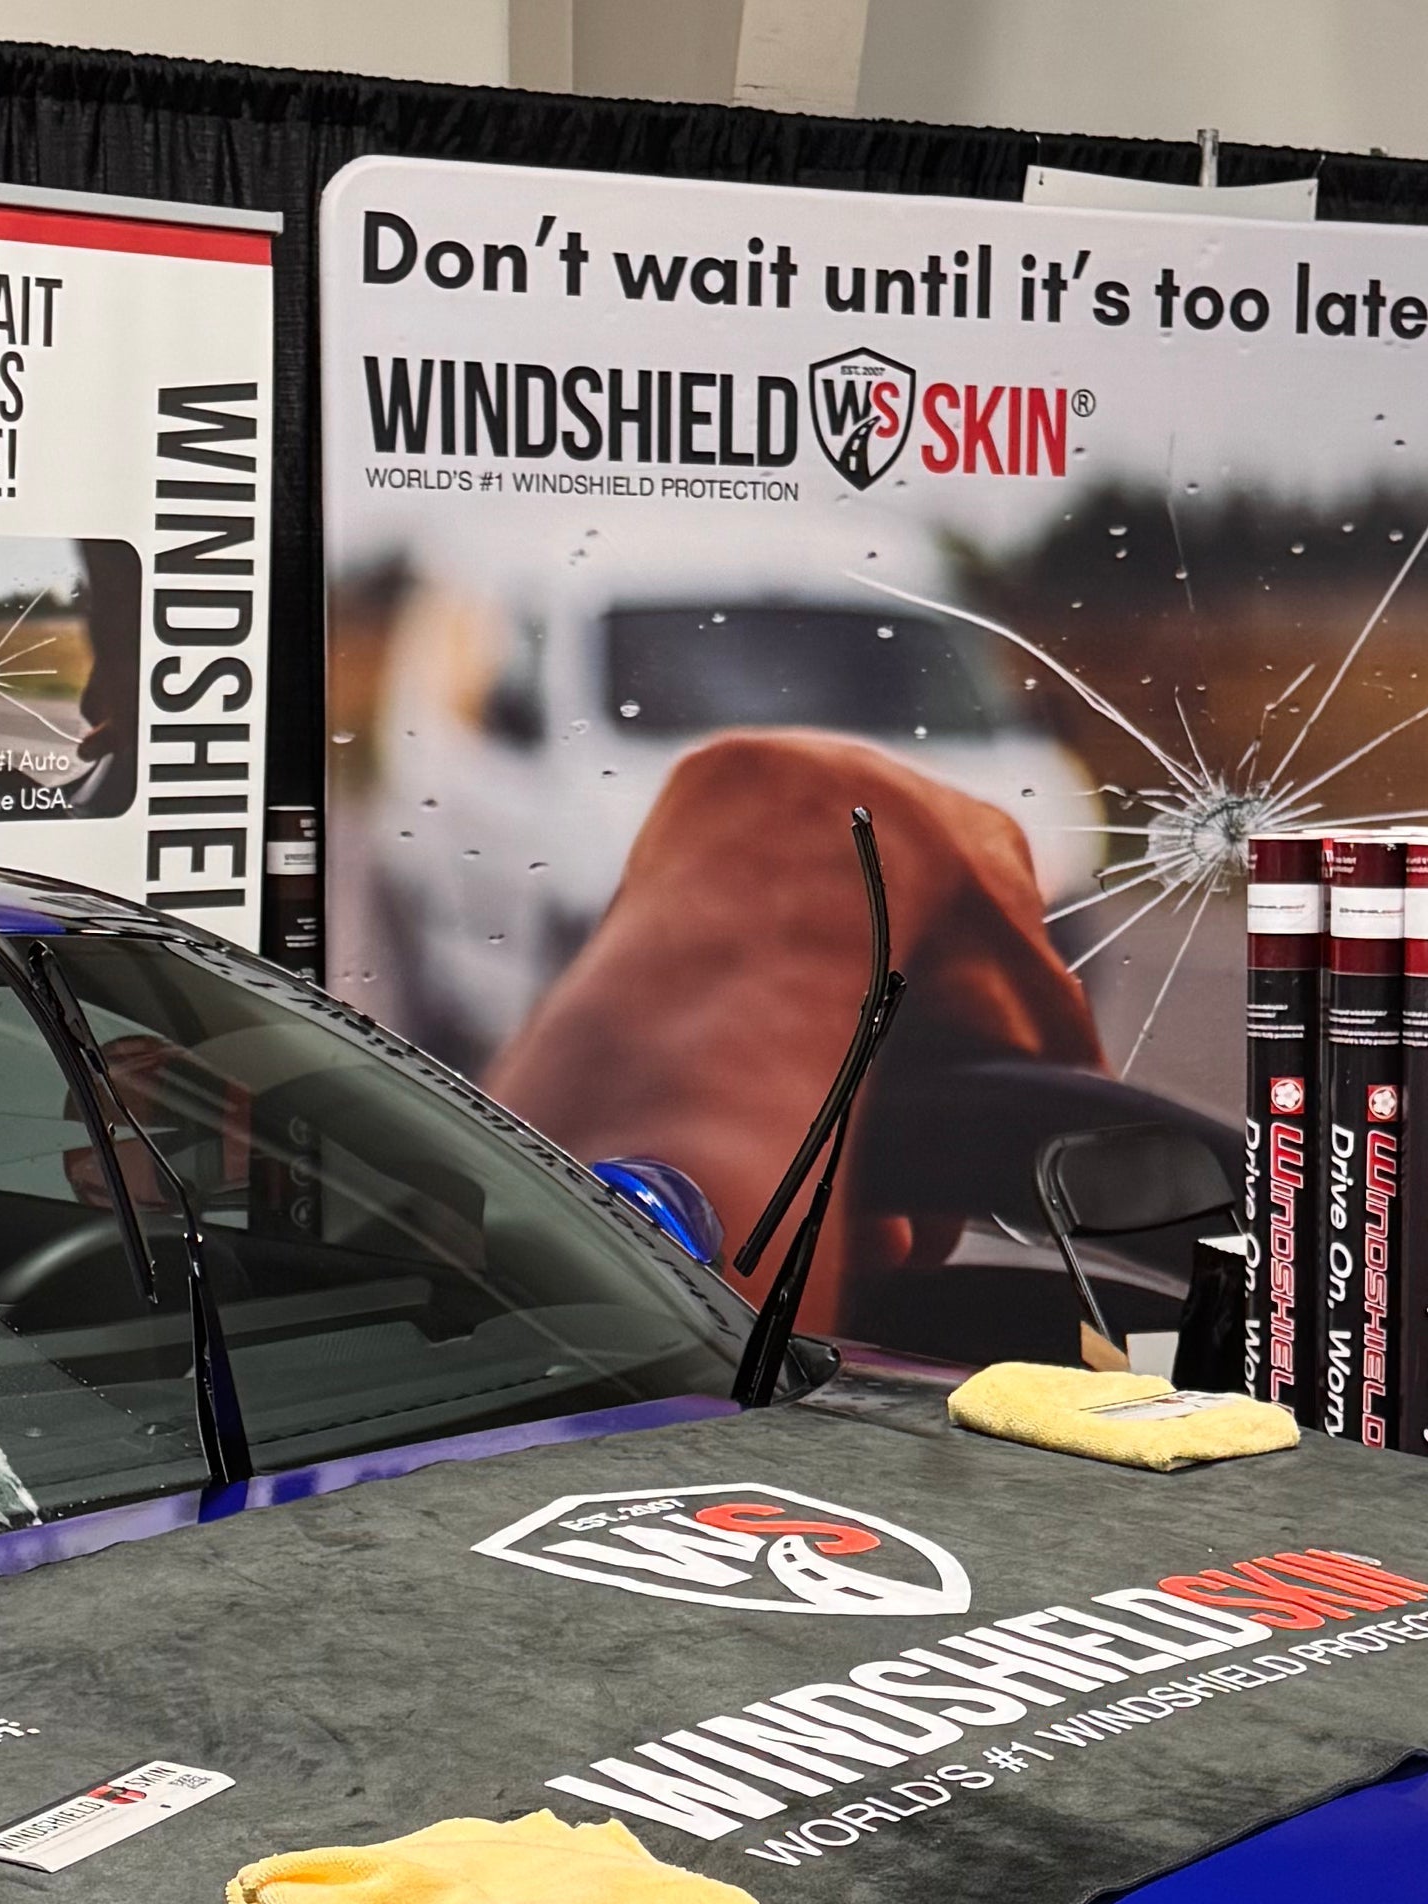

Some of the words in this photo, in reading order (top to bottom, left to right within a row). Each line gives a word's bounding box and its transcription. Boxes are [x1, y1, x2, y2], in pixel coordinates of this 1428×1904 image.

[362, 210, 590, 297] Don't
[612, 236, 798, 309] wait
[825, 243, 992, 320] until
[1020, 249, 1131, 328] it's
[1154, 266, 1270, 333] too
[363, 354, 798, 469] WINDSHIELD
[366, 467, 473, 494] WORLD'S
[479, 472, 506, 494] #1
[512, 472, 655, 498] WINDSHIELD
[662, 478, 799, 502] PROTECTION
[19, 749, 70, 772] Auto
[1330, 1122, 1355, 1230] Drive
[544, 1587, 1273, 1841] WINDSHIELD
[744, 1764, 995, 1866] WORLD'S
[982, 1739, 1055, 1773] #1
[1034, 1656, 1307, 1748] WINDSHIELD
